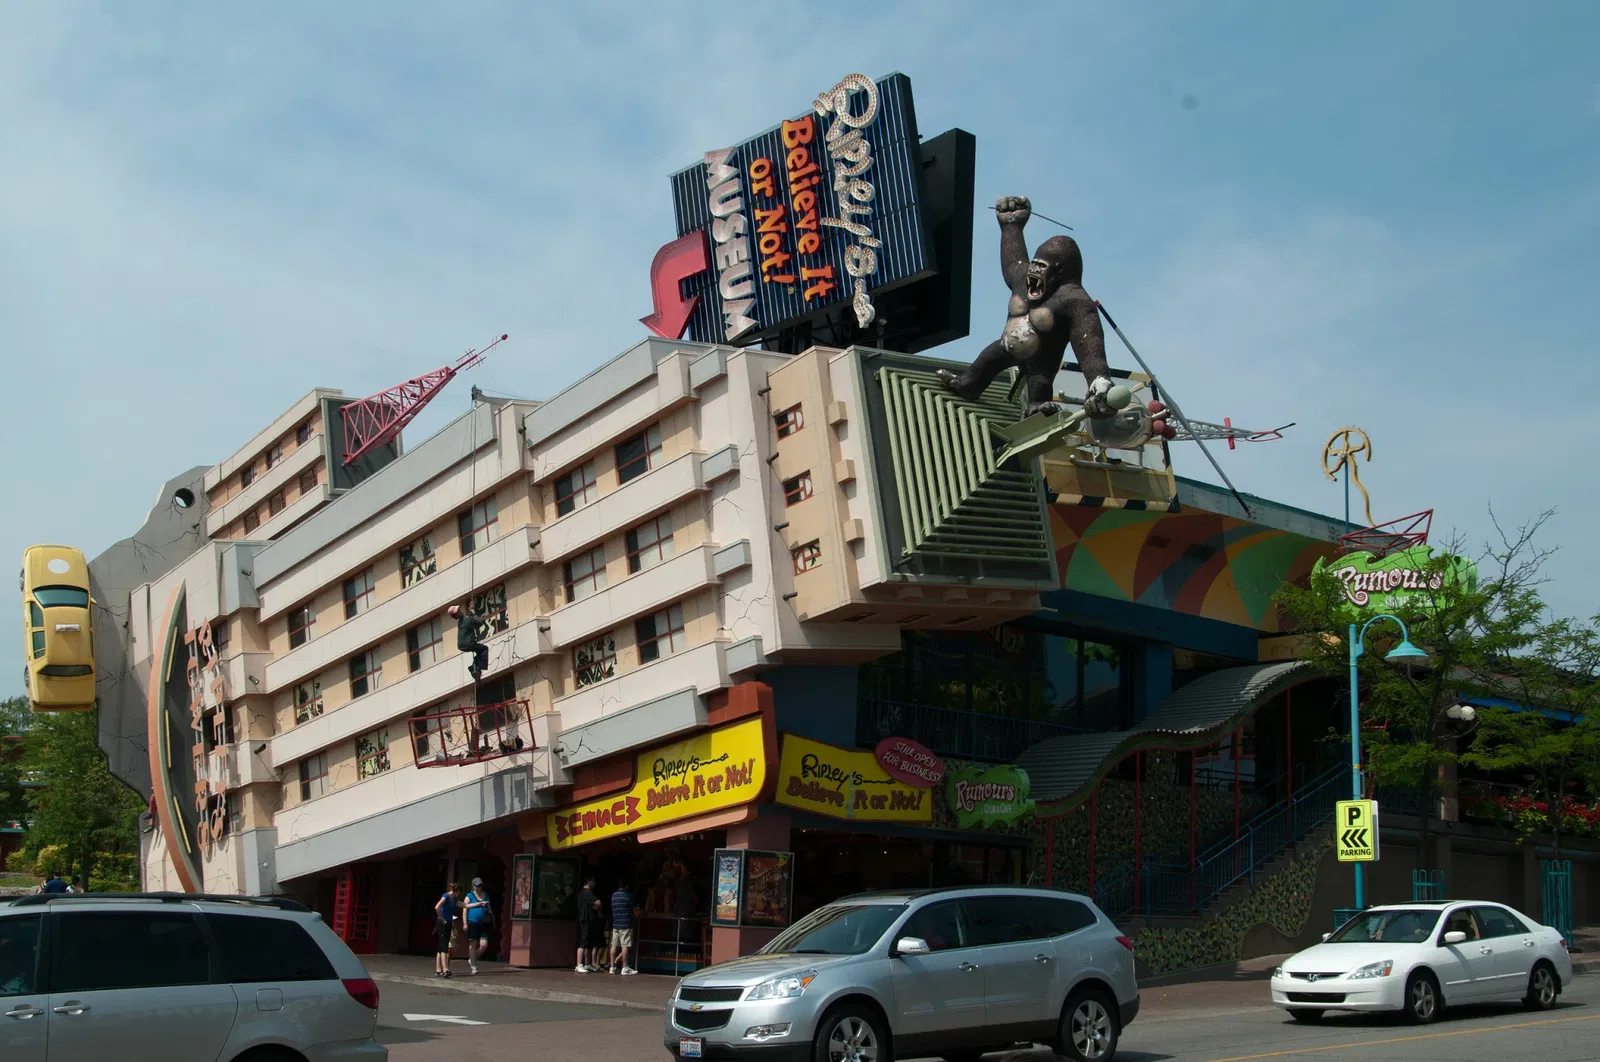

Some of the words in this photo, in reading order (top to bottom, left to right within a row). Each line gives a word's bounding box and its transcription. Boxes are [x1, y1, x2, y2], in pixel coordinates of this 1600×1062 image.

[749, 157, 776, 199] or
[782, 115, 823, 256] Believe
[812, 73, 884, 329] Ripley's
[704, 147, 760, 341] MUSEUM
[754, 203, 799, 285] Not!
[801, 264, 839, 302] It
[198, 615, 227, 842] RIPLEY'S
[882, 751, 900, 767] FOR
[899, 759, 943, 783] BUSINESS!
[914, 752, 937, 769] OPEN
[646, 782, 690, 811] Believe
[692, 773, 706, 798] It
[706, 775, 723, 794] or
[724, 758, 754, 790] Not!
[785, 775, 845, 809] Believe
[852, 787, 868, 810] It
[870, 792, 888, 810] or
[888, 789, 924, 811] Not!
[955, 779, 1015, 812] Rumours
[1348, 807, 1361, 826] P
[1340, 848, 1372, 856] PARKING
